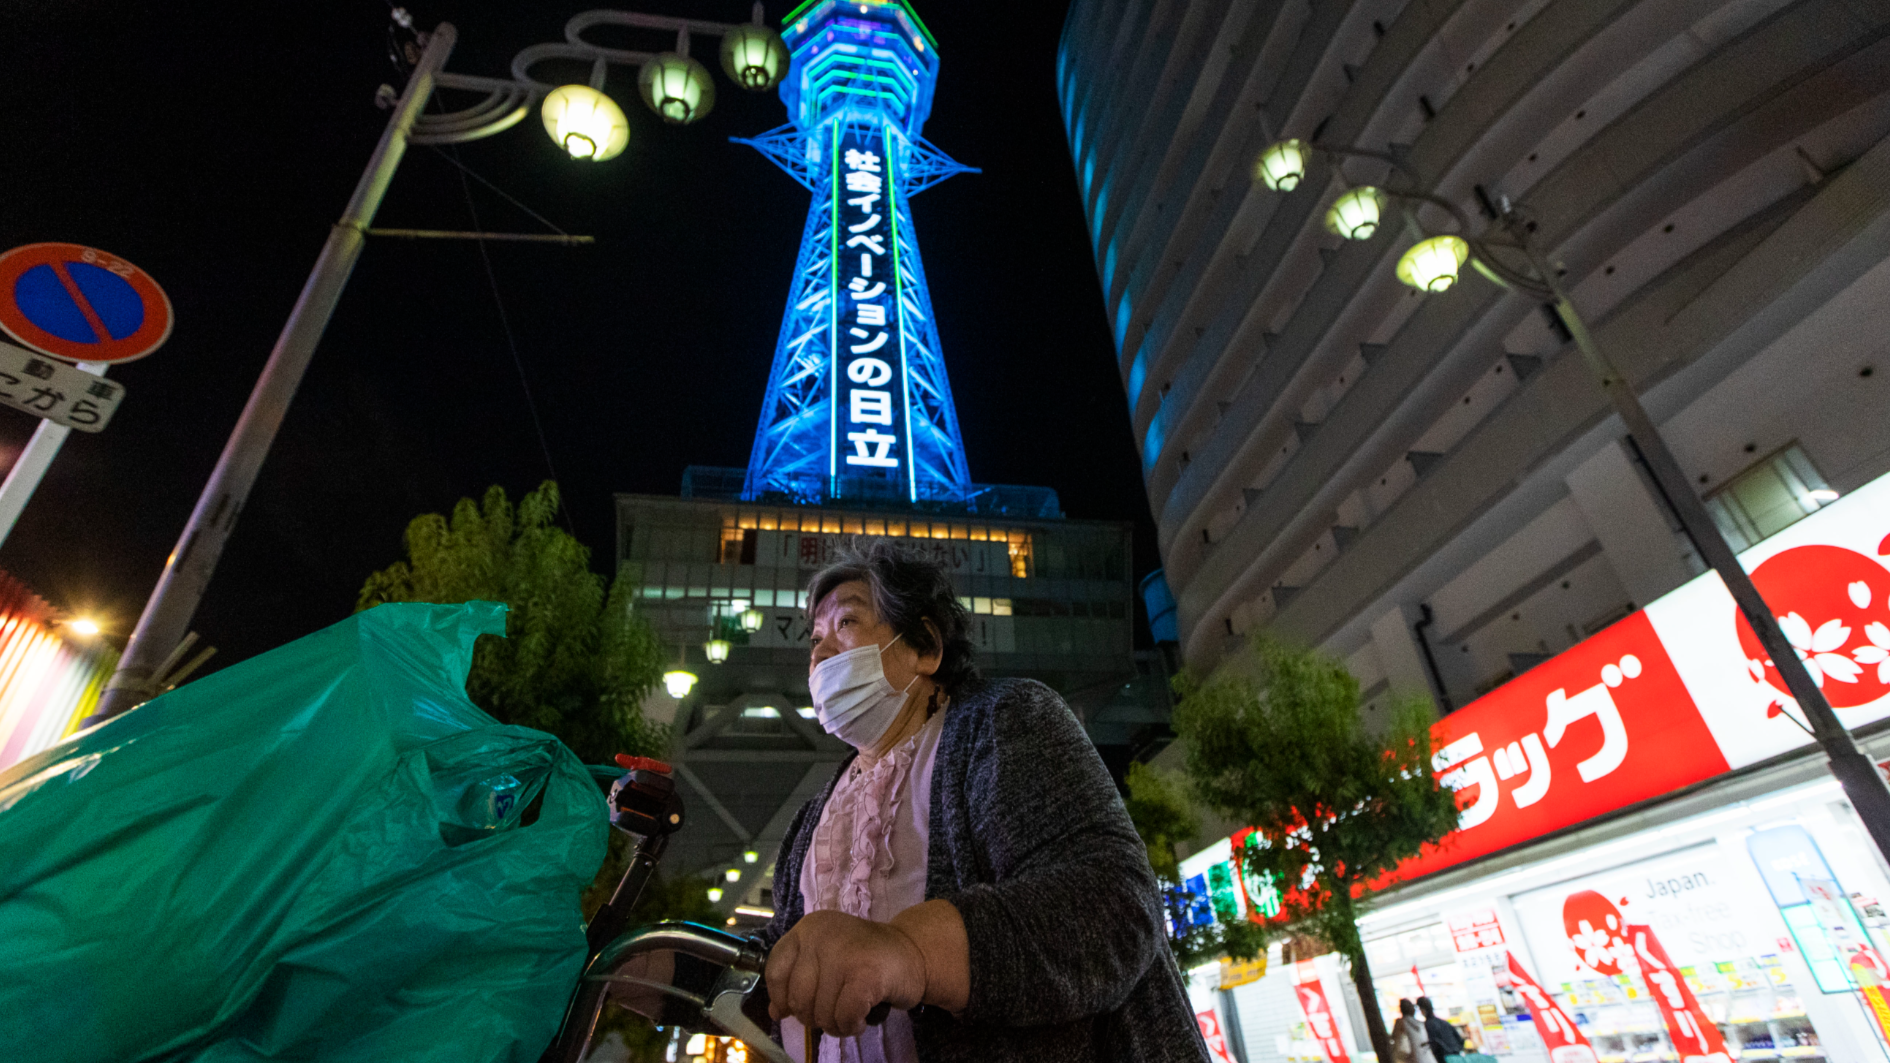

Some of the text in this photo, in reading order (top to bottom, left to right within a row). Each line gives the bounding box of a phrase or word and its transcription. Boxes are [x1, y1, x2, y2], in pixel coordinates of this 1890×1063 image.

[844, 148, 899, 468] 社会イノベーションの日立
[1430, 653, 1642, 831] ラッグ
[1688, 930, 1748, 955] Shop
